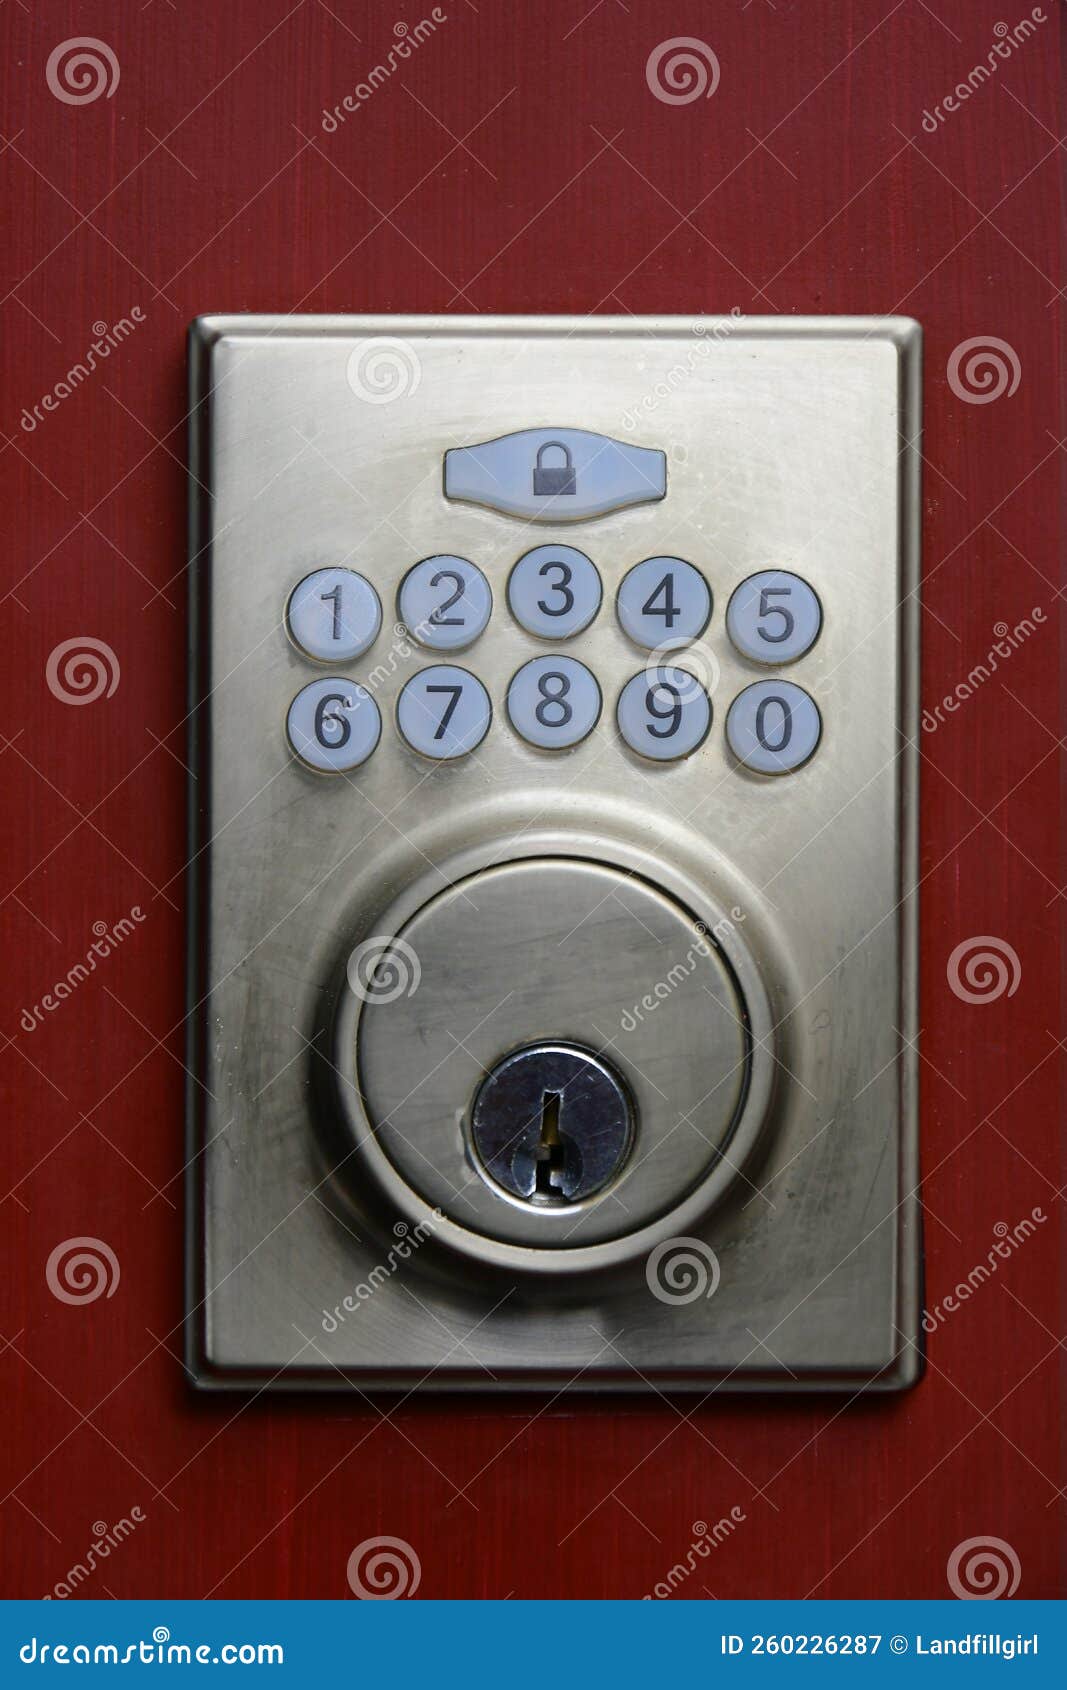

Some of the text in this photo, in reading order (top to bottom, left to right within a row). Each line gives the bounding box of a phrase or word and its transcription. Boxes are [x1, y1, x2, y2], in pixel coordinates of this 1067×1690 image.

[321, 561, 795, 643] 1 2 3 4 5
[314, 671, 793, 752] 6 7 8 9 0
